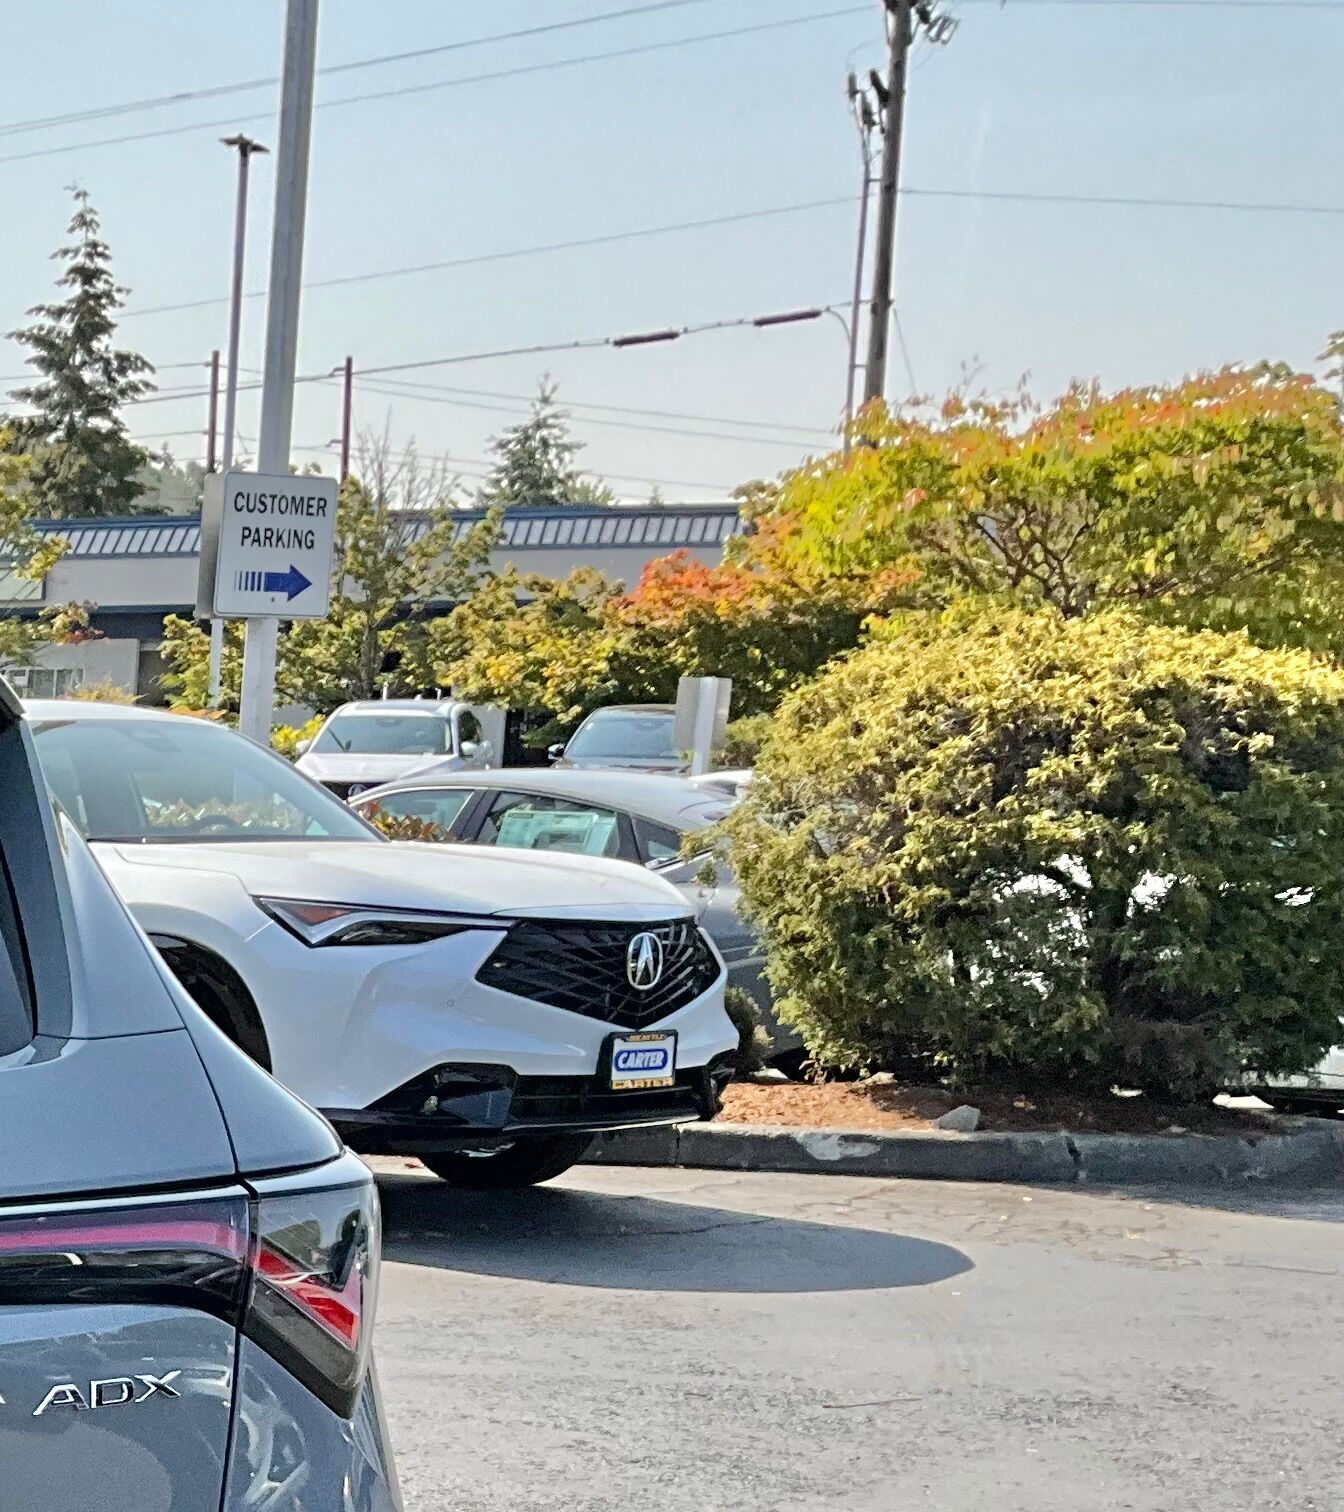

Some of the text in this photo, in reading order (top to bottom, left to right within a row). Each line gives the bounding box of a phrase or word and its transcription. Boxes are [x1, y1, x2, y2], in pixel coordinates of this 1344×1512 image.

[234, 491, 327, 517] CUSTOMER
[240, 526, 315, 550] PARKING
[618, 1051, 664, 1068] CARTER
[32, 1369, 181, 1416] ADX
